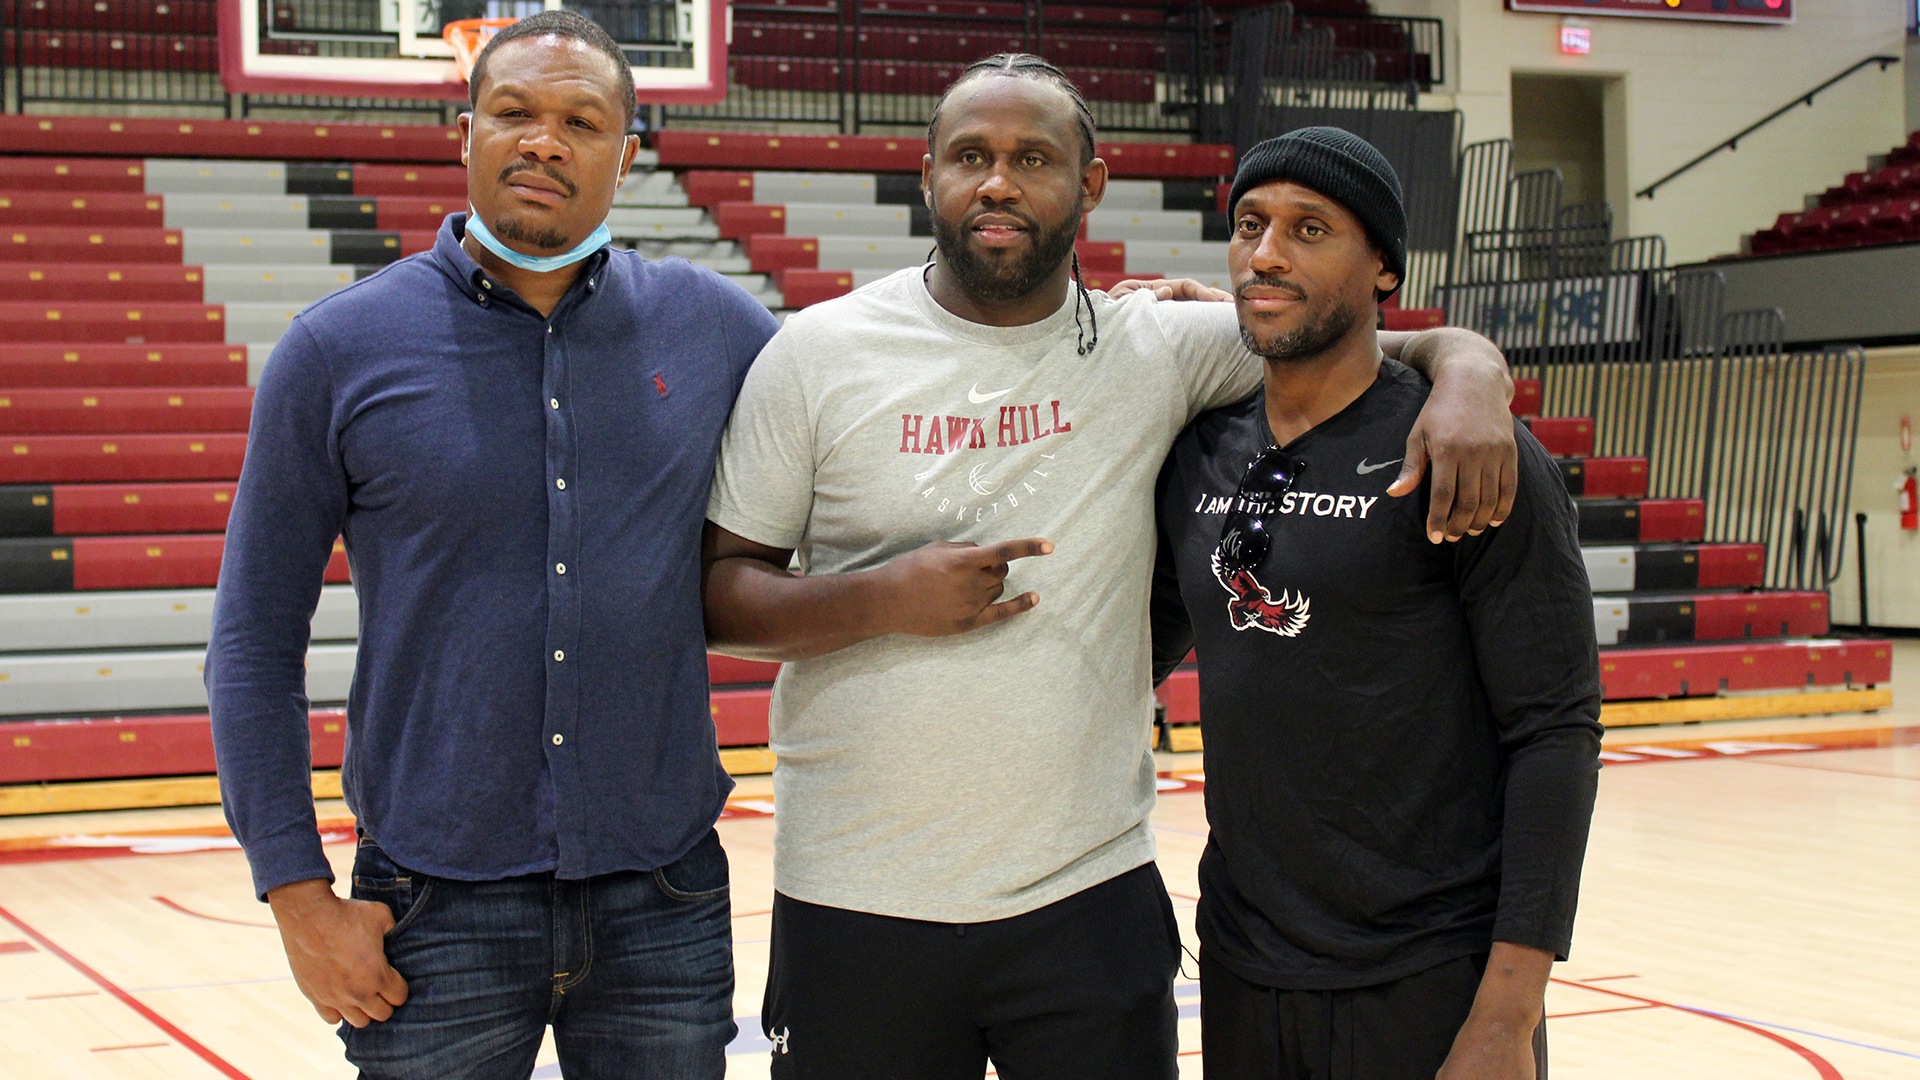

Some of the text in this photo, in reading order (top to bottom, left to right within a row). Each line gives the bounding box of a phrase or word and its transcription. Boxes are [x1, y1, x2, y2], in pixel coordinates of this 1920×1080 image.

[900, 400, 1072, 455] HAWK HILL
[914, 453, 1055, 522] BASKETBALL
[1195, 493, 1208, 514] I
[1204, 497, 1234, 515] AM
[1279, 491, 1379, 519] STORY
